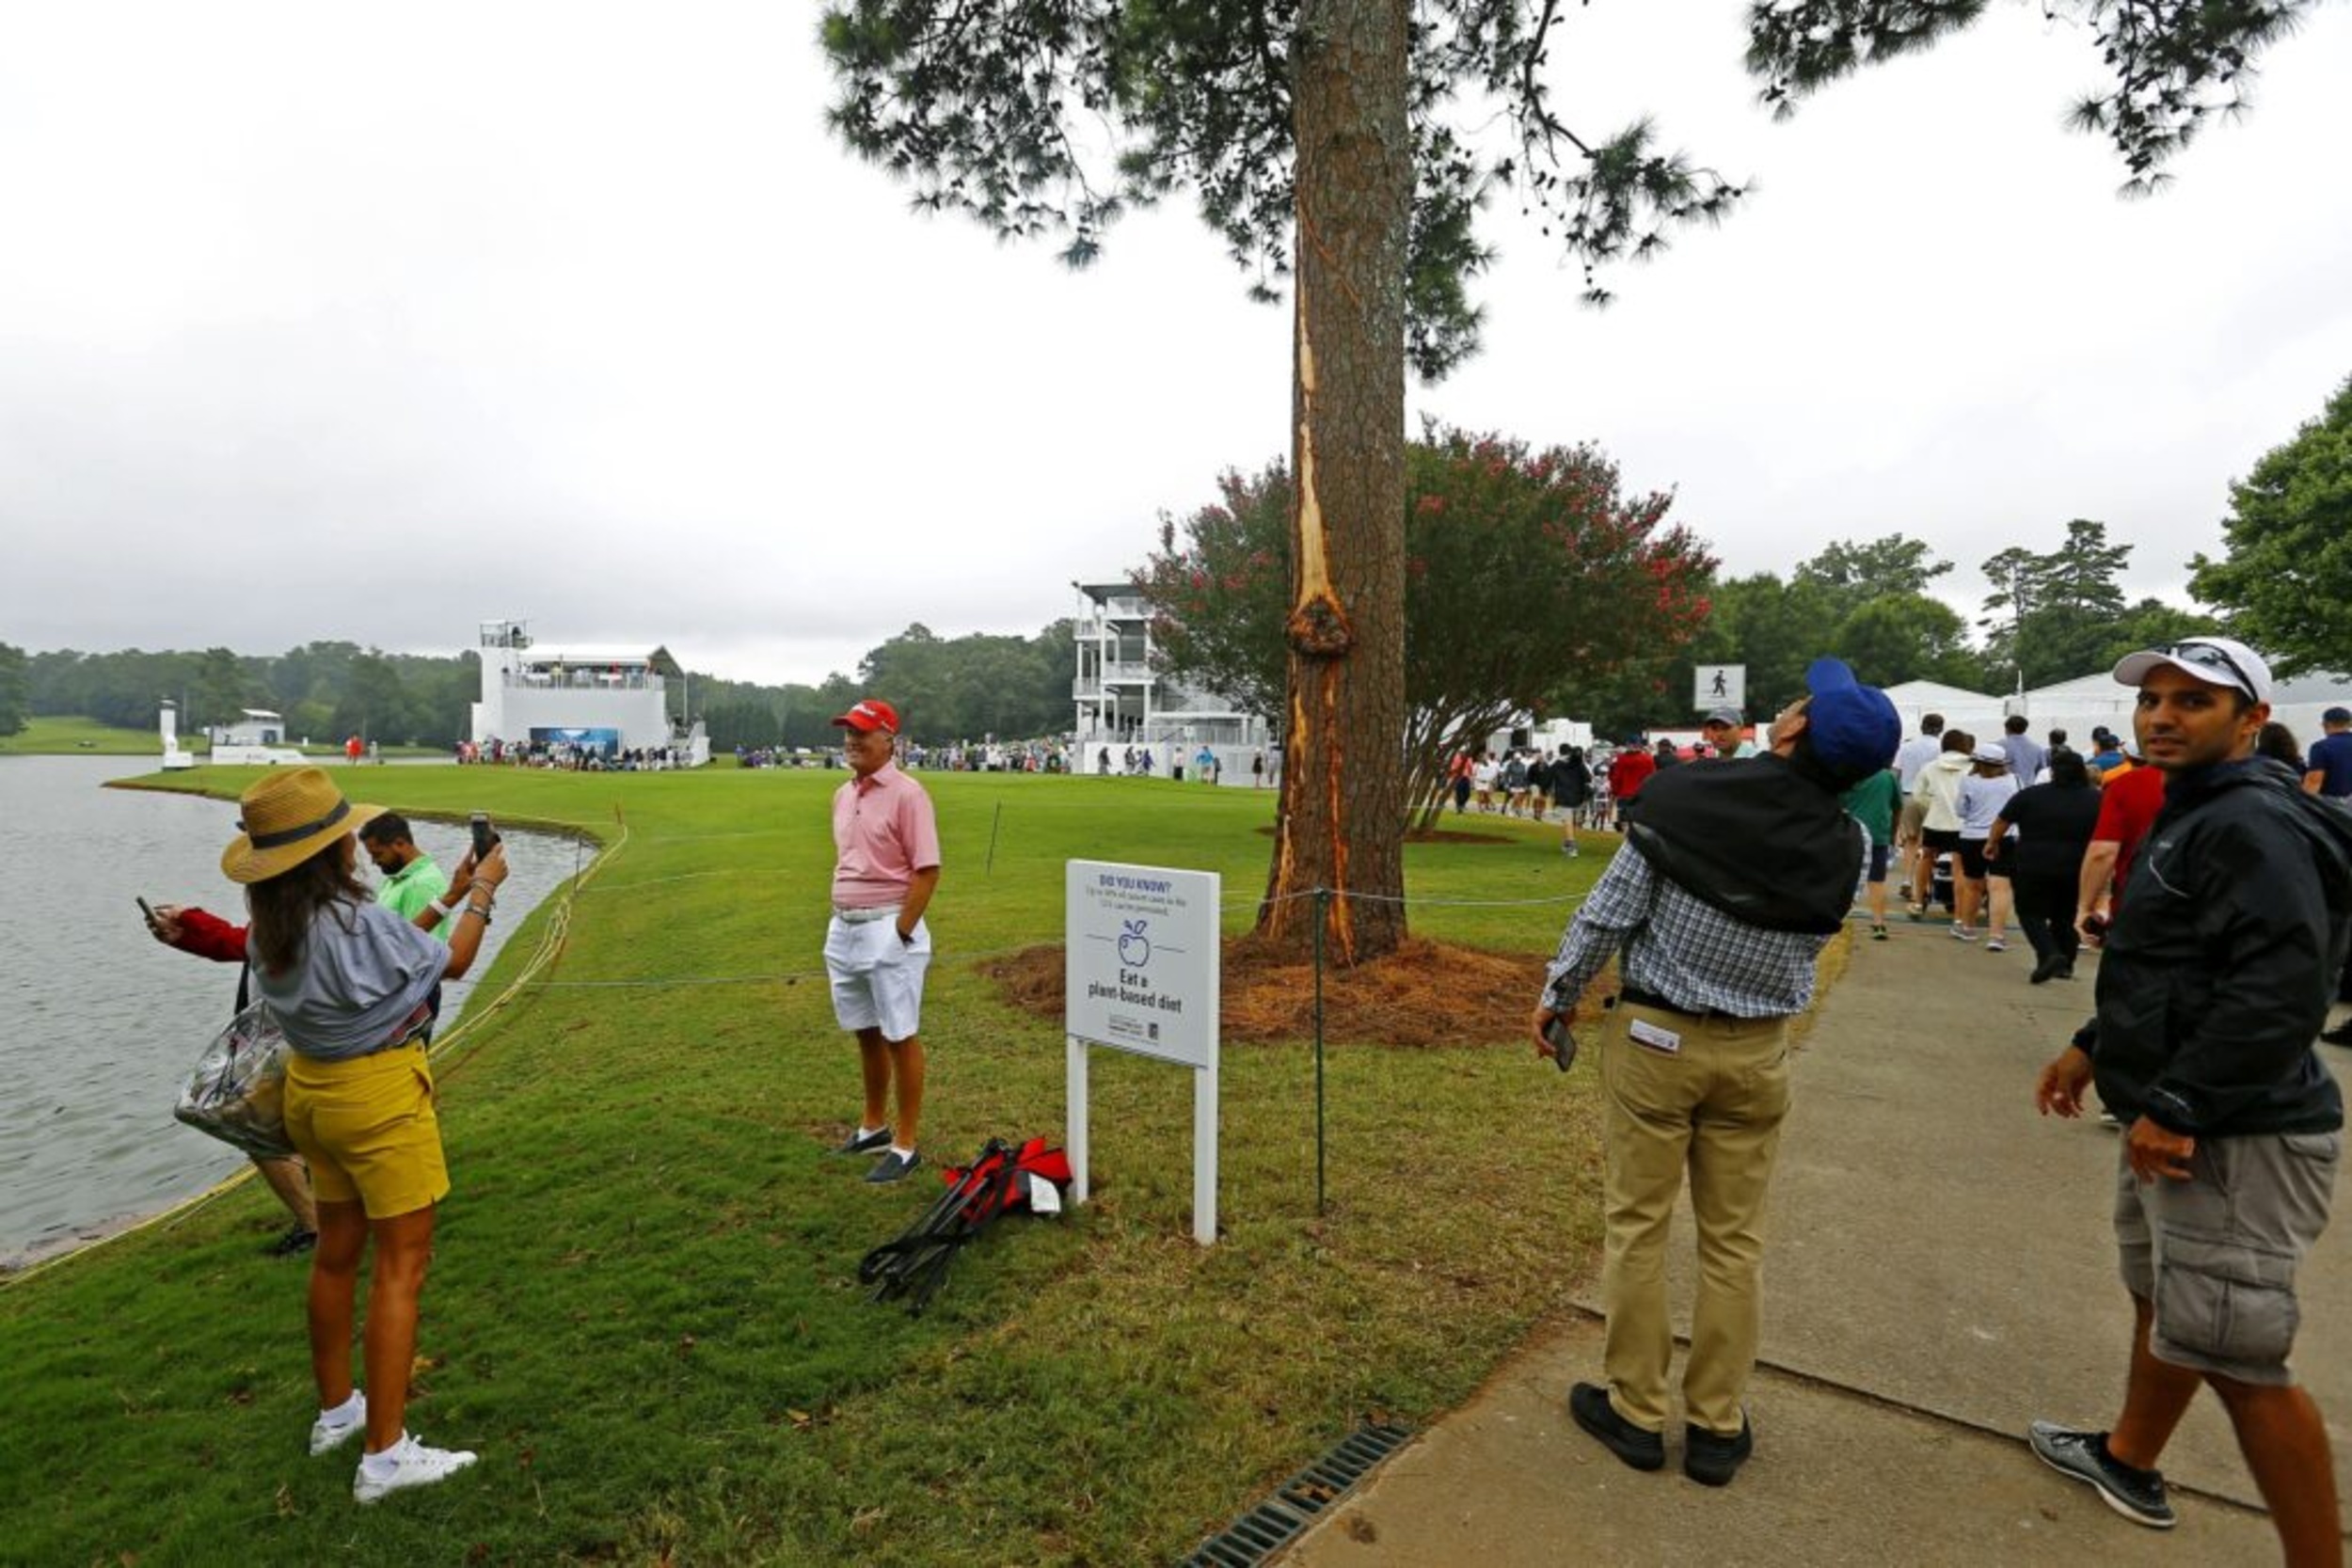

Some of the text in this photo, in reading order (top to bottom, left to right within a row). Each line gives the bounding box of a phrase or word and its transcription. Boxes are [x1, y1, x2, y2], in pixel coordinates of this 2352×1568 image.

[1099, 875, 1172, 894] DID YOU KNOW?
[1120, 968, 1148, 988] Eat a
[1088, 980, 1182, 1014] plant-based diet
